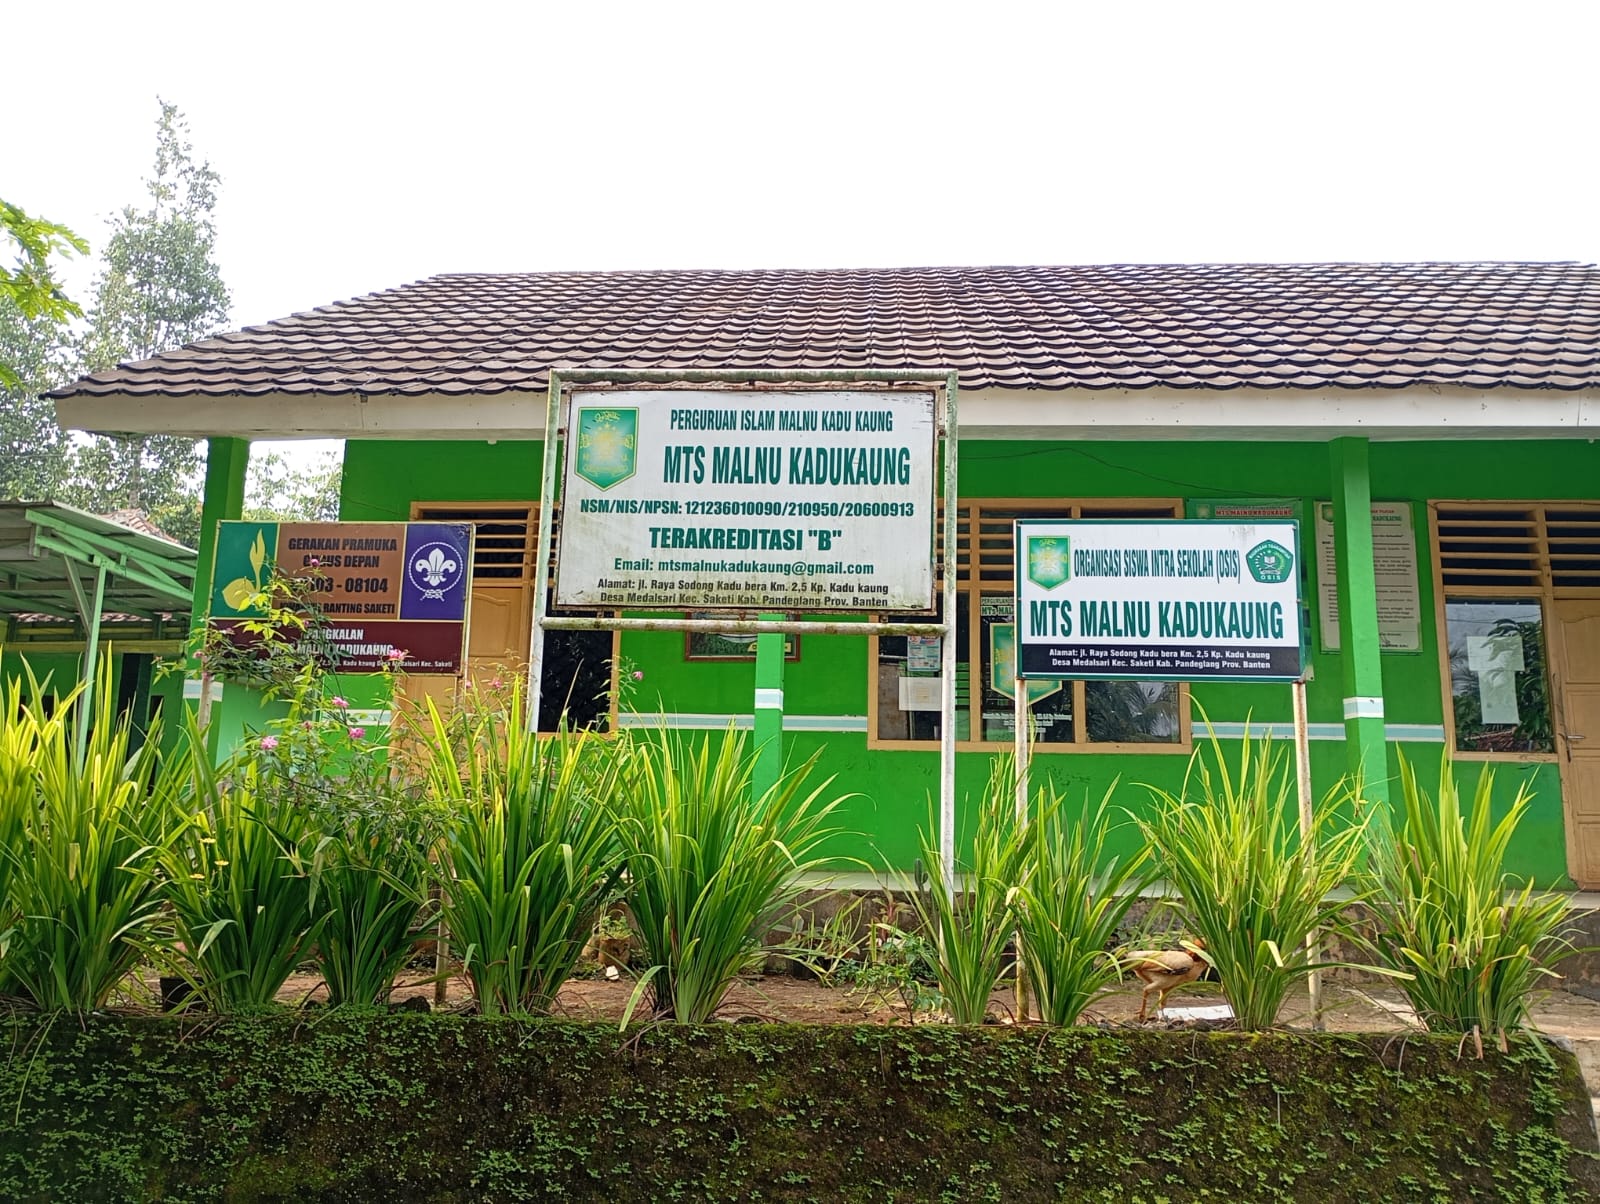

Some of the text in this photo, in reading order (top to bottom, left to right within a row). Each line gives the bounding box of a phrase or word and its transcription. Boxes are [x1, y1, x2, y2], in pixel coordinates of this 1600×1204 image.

[671, 410, 892, 432] PERGURUAN ISLAM MALNU KADU KAUNG
[664, 446, 910, 485] MTS MALNU KADUKAUNG
[581, 499, 913, 516] NSM/NIS/NPSN: 121236010090/210950/20600913
[289, 538, 397, 551] GERAKAN PRAMUKA
[649, 528, 841, 550] TERAKREDITASI "B"
[344, 556, 379, 567] DEPAN
[615, 558, 873, 576] Email: mtsmalnukadukaung@gmail.com
[1074, 550, 1240, 583] ORGANISASI SISWA INTRA SEKOLAH (OSIS)
[345, 578, 388, 592] 08104
[597, 579, 634, 589] Alamat:
[650, 580, 674, 591] Raya
[678, 581, 712, 593] Sodong
[716, 582, 741, 592] Kadu
[744, 582, 766, 592] bera
[770, 582, 788, 592] Km.
[791, 583, 807, 594] 2,5
[810, 583, 826, 595] Kp.
[830, 584, 854, 594] Kadu
[858, 584, 888, 596] kaung
[323, 603, 362, 613] RANTING
[364, 603, 395, 614] SAKETI
[600, 593, 623, 602] Desa
[678, 594, 699, 604] Kec.
[703, 594, 734, 604] Saketi
[738, 595, 758, 604] Kab.
[763, 596, 820, 606] Pandeglang
[824, 597, 848, 606] Prov.
[852, 598, 888, 607] Banten
[1031, 600, 1283, 639] MTS MALNU KADUKAUNG
[1090, 649, 1108, 658] Raya
[1110, 650, 1138, 658] Sodong
[1197, 650, 1209, 659] 2,5
[1211, 650, 1223, 659] Kp.
[1246, 651, 1270, 659] kaung
[1052, 658, 1070, 666] Desa
[1130, 659, 1154, 667] Saketi
[1156, 659, 1173, 667] Kab.
[1175, 660, 1220, 669] Pandeglang
[1222, 660, 1241, 668] Prov.
[1243, 660, 1270, 668] Banten
